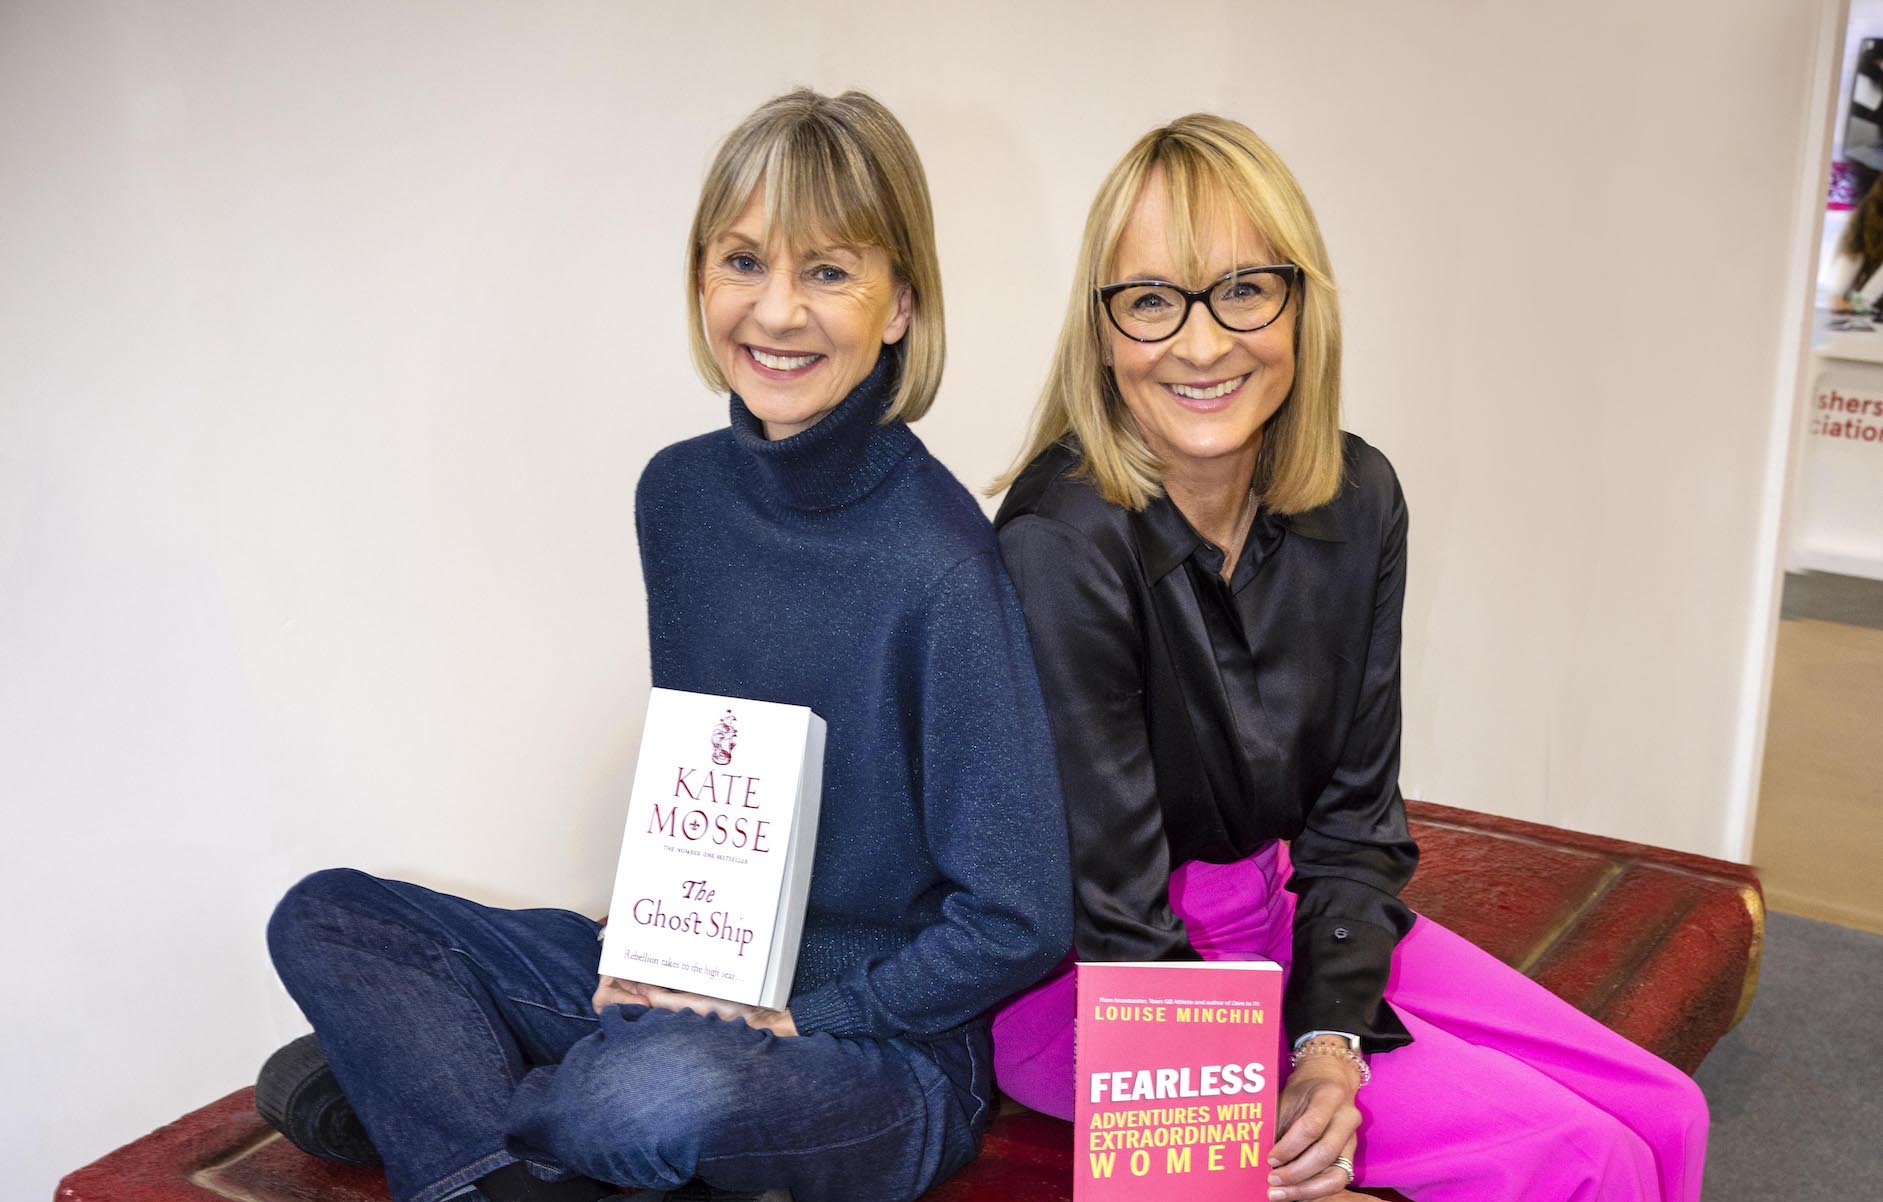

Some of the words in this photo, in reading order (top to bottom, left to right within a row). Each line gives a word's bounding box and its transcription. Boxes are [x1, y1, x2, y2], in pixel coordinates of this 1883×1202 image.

[1817, 390, 1883, 417] shers
[673, 767, 760, 809] KATE
[646, 804, 770, 853] MOSSE
[682, 880, 715, 903] The
[632, 898, 702, 935] Ghost
[706, 911, 753, 956] Ship
[624, 949, 659, 965] Rebellion
[661, 957, 680, 969] takes
[681, 962, 690, 971] to
[691, 962, 703, 973] the
[704, 964, 719, 980] high
[1095, 1005, 1167, 1022] LOUISE
[1176, 1008, 1264, 1024] MINCHIN
[1090, 1062, 1266, 1103] FEARLESS
[1089, 1106, 1211, 1130] ADVENTURES
[1216, 1102, 1262, 1121] WITH
[1089, 1121, 1264, 1151] EXTRAORDINARY
[1089, 1142, 1260, 1179] WOMEN
